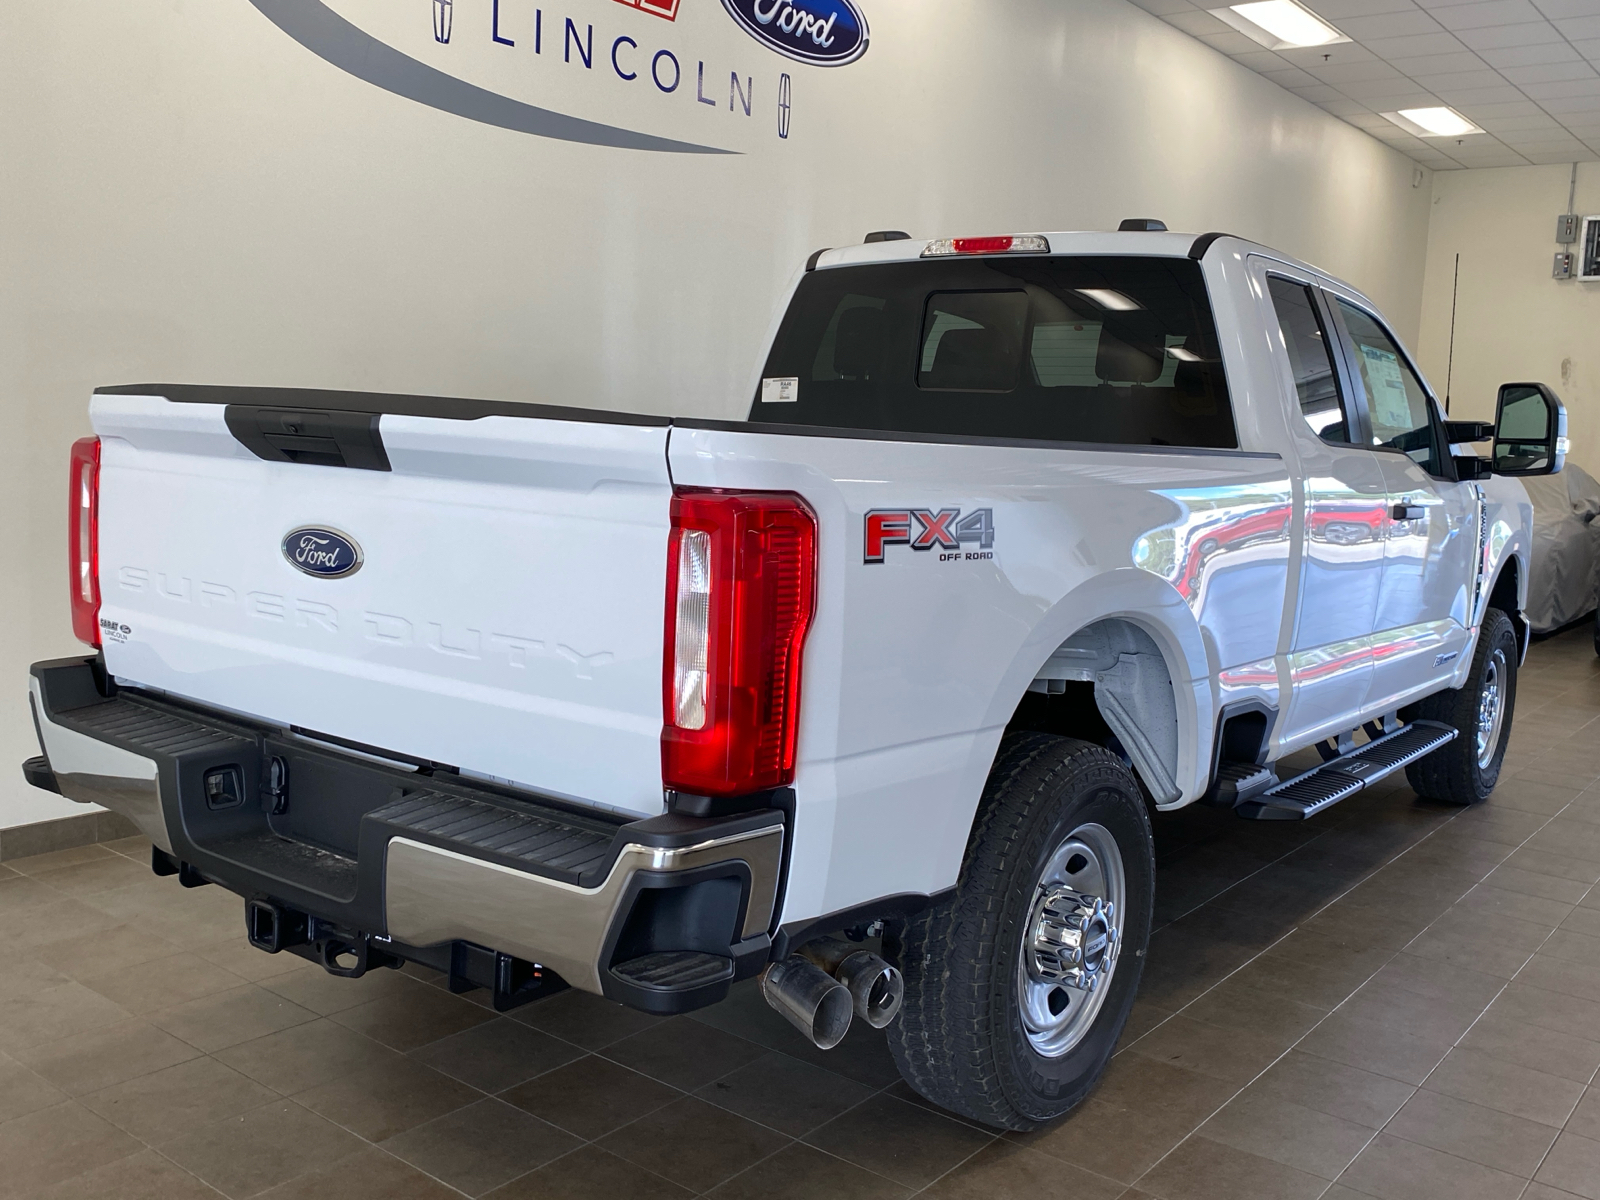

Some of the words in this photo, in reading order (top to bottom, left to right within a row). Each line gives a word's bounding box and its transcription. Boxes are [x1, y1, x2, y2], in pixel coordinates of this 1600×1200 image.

[491, 0, 753, 117] LINCOLN
[296, 535, 340, 568] Ford
[863, 508, 995, 565] FX4
[939, 553, 962, 562] OFF
[965, 551, 994, 561] ROAD
[119, 565, 339, 633] SUPER
[363, 610, 615, 681] DUTY
